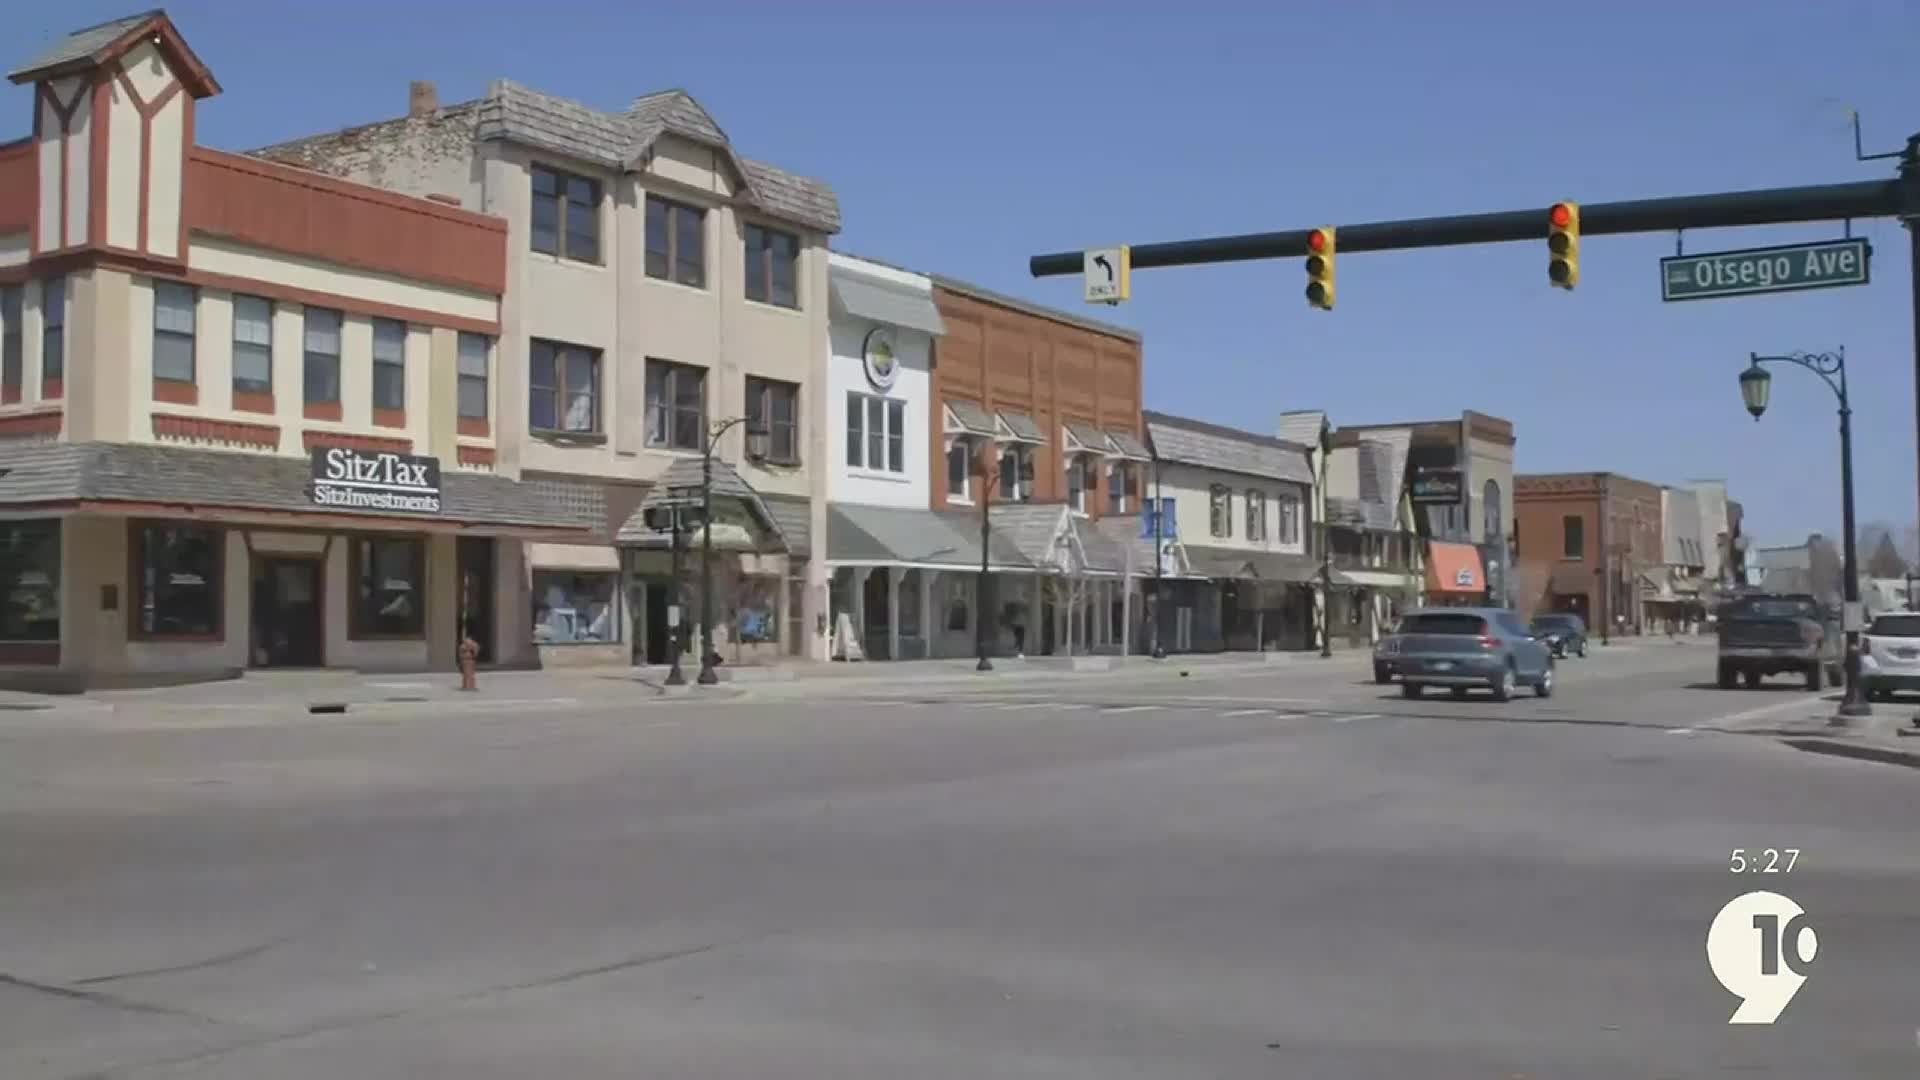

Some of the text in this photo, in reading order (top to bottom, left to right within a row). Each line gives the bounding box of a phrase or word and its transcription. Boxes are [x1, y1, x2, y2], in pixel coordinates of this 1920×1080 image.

[1695, 249, 1856, 287] Otsego Ave
[326, 447, 429, 486] SitzTax
